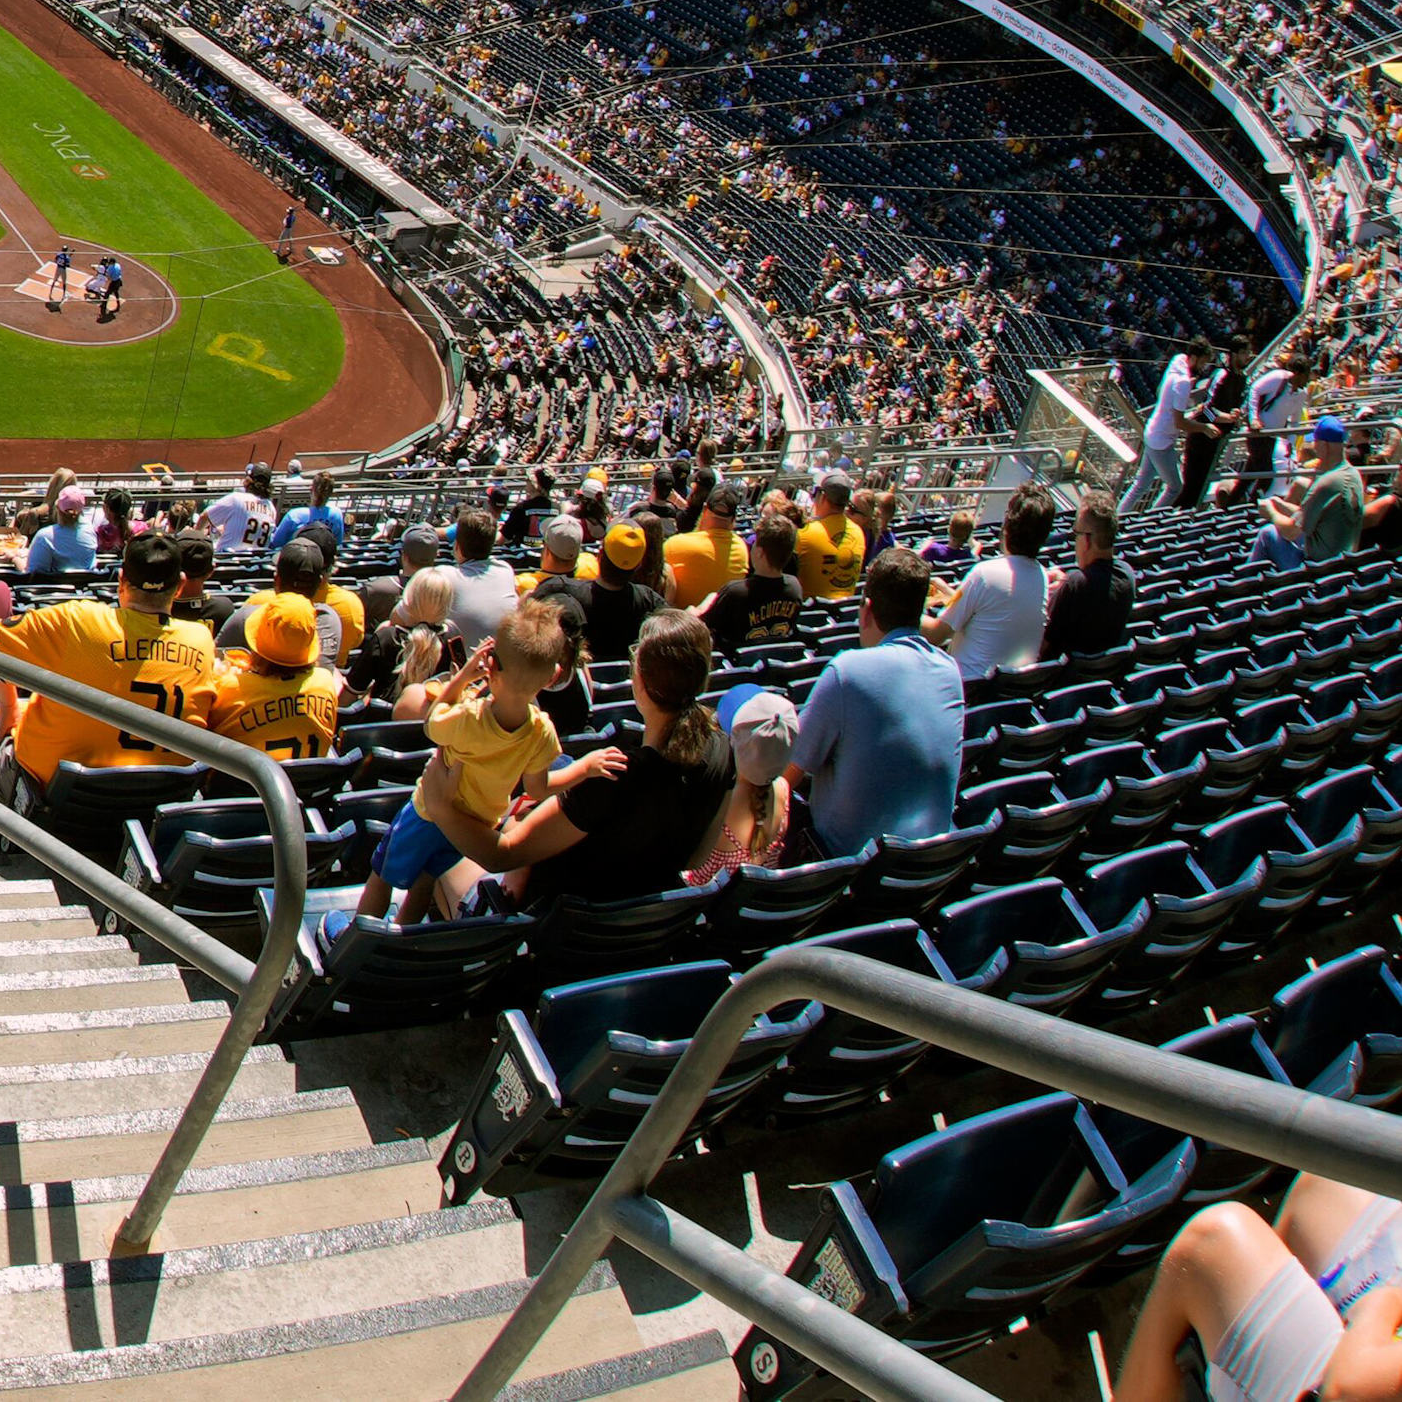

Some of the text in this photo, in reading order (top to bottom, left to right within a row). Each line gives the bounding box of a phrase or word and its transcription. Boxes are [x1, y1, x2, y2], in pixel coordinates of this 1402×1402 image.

[209, 51, 402, 188] WELCOME TO PNC PARK
[32, 121, 92, 162] PNC
[206, 331, 294, 382] P
[243, 518, 271, 548] 23
[109, 637, 206, 674] CLEMENTE
[238, 694, 335, 733] CLEMENTE
